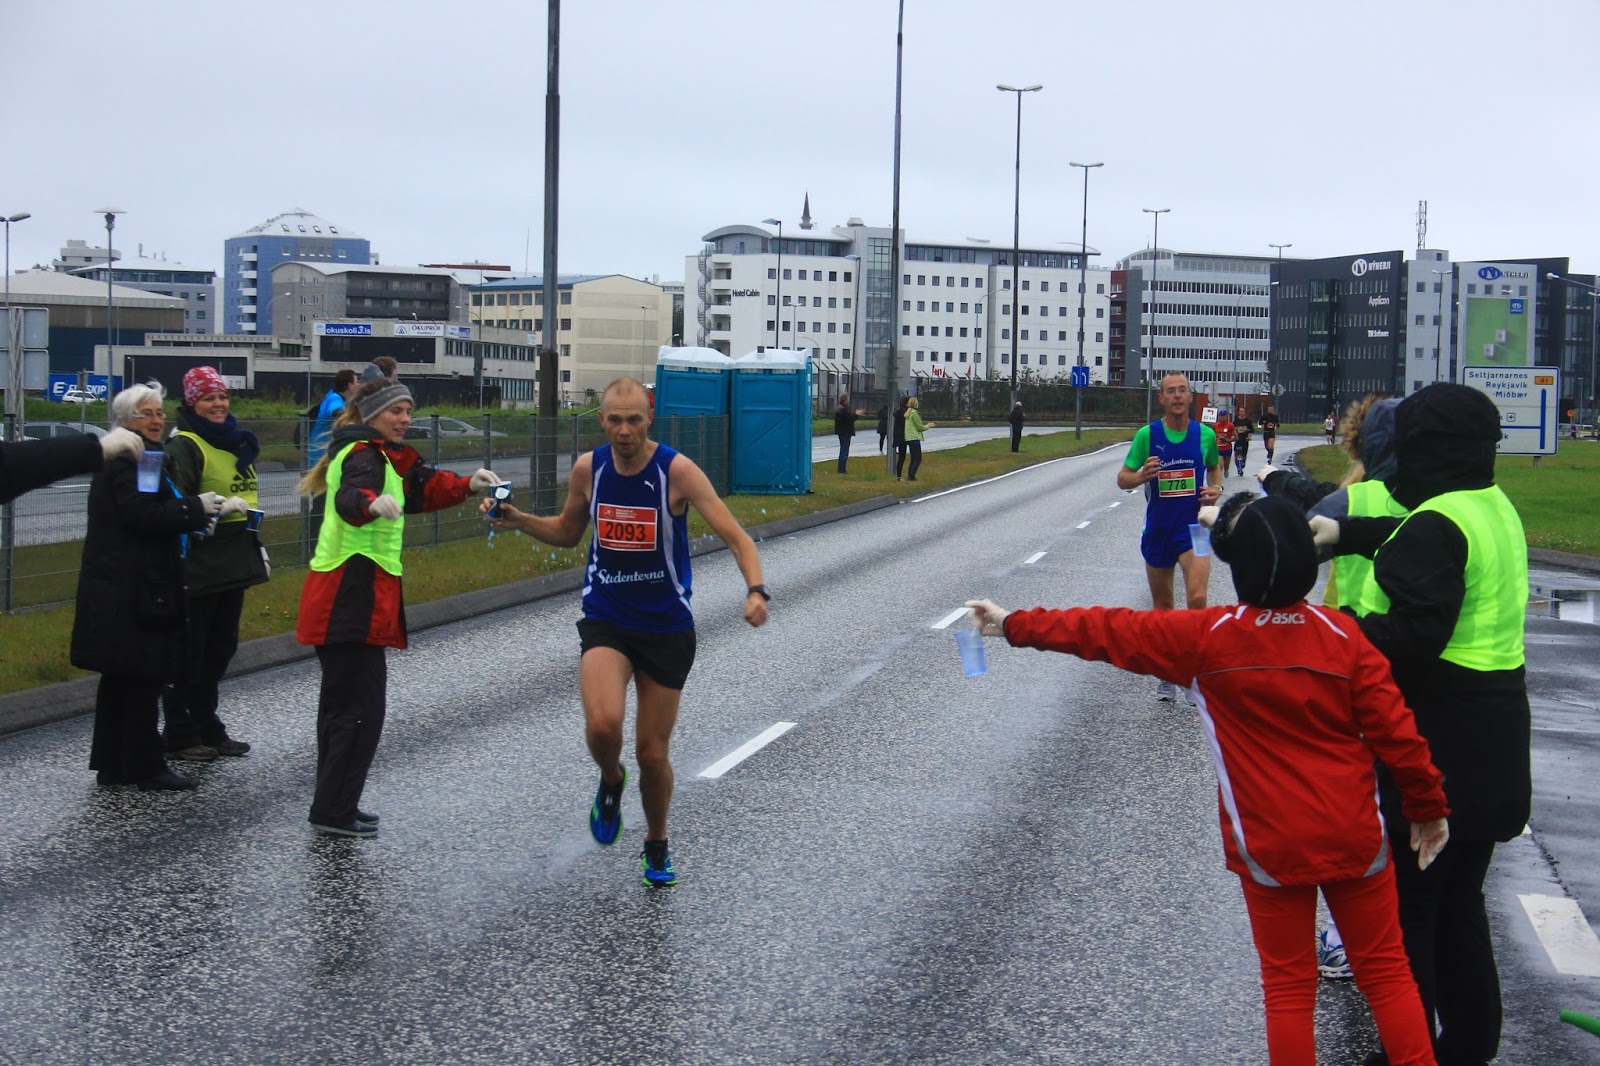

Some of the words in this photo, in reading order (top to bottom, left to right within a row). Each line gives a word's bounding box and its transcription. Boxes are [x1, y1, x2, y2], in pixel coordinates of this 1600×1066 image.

[732, 289, 745, 297] Hotel
[745, 289, 760, 297] Cabin
[1468, 371, 1529, 379] Seltjarnarnes
[1167, 479, 1187, 491] 778
[605, 521, 646, 542] 2093
[597, 568, 665, 585] Studenterna
[1271, 612, 1306, 625] asics
